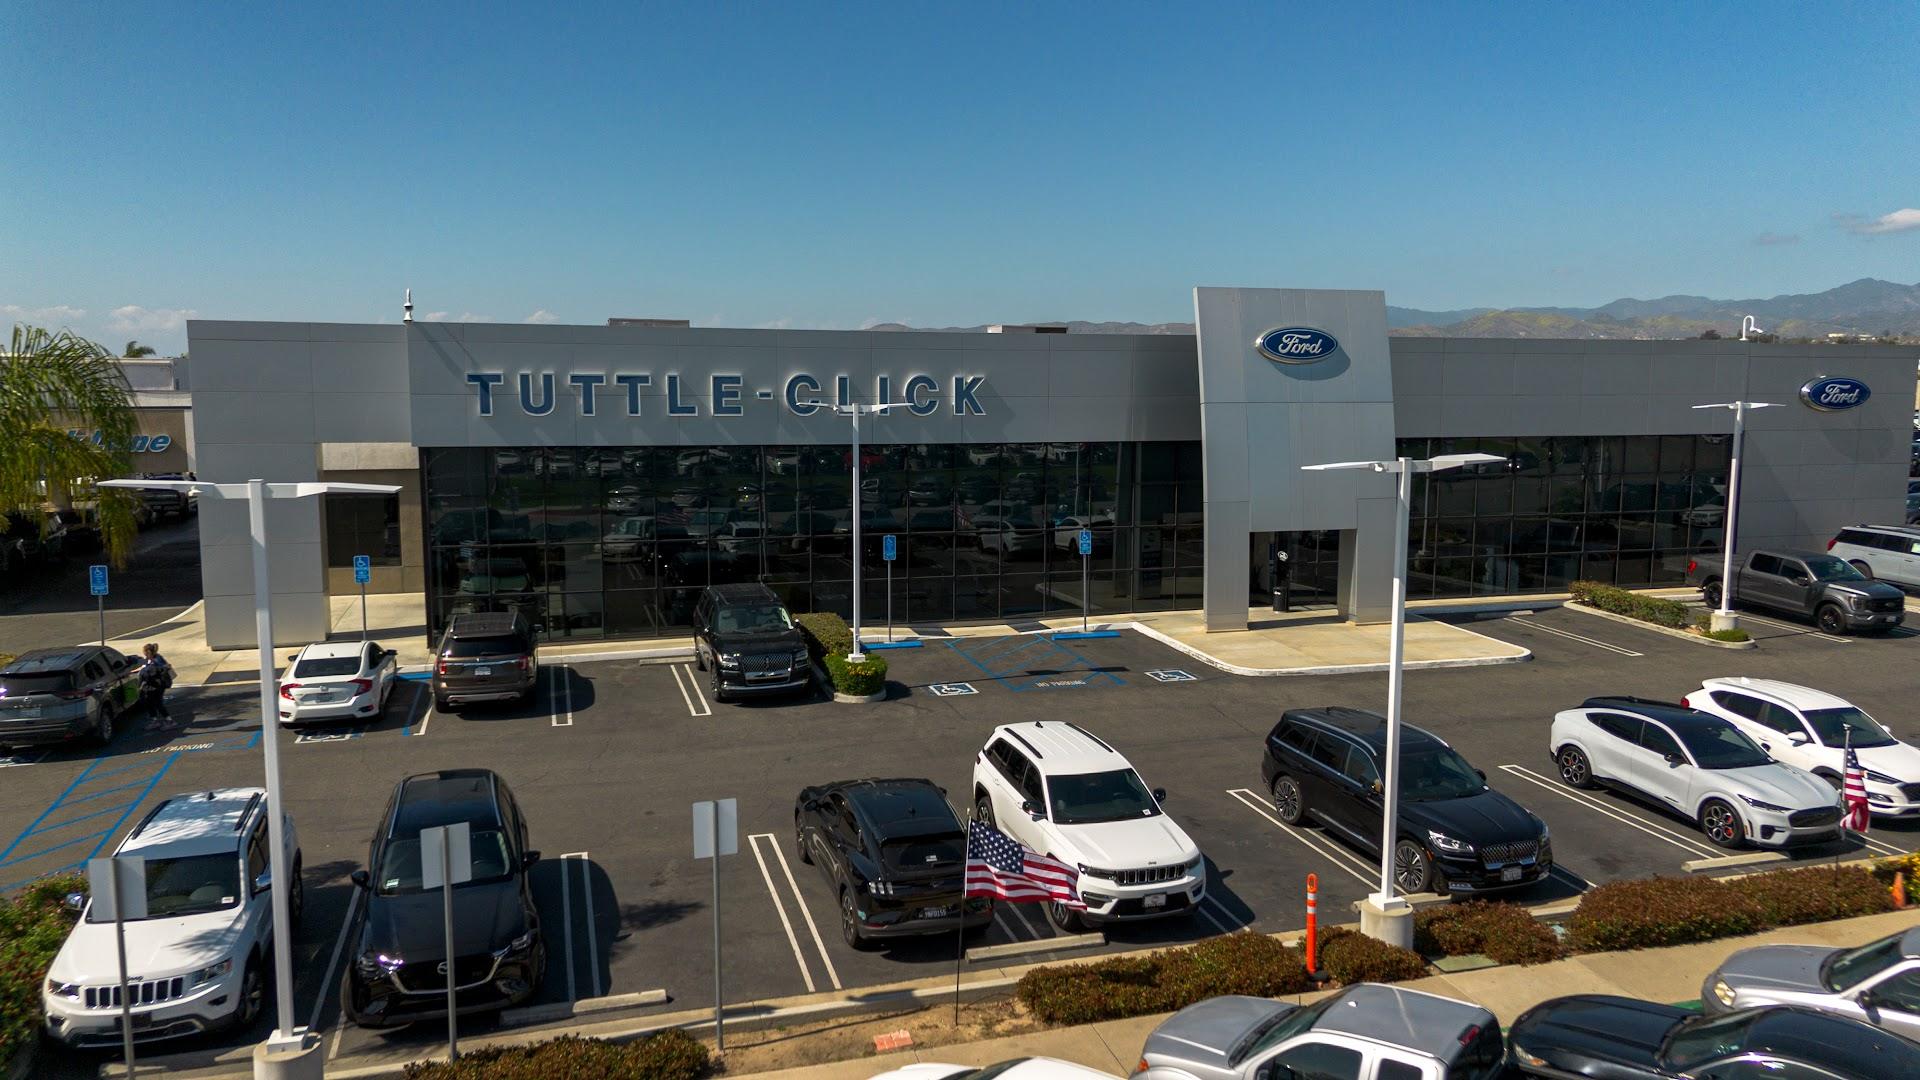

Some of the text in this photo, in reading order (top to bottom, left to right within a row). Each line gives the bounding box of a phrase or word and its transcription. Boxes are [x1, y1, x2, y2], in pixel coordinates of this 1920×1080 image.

[1279, 333, 1323, 354] Ford
[464, 371, 987, 416] TUTTLE-CLICK
[1821, 383, 1860, 404] Ford
